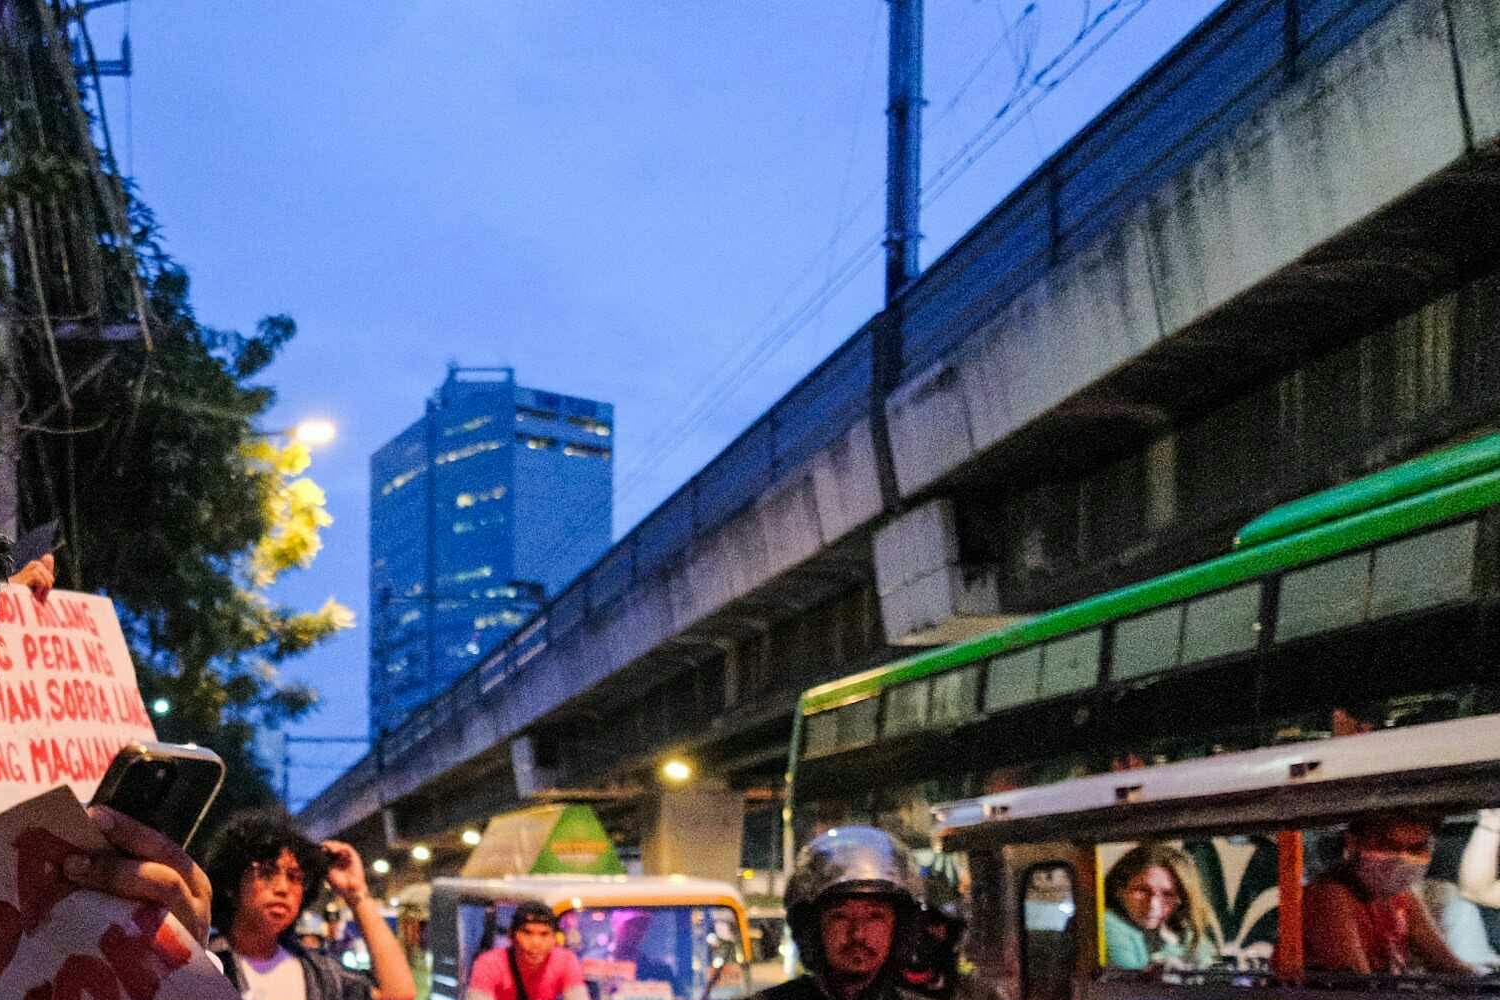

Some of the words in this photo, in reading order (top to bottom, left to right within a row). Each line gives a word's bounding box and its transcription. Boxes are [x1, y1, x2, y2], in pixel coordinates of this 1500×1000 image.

[22, 633, 83, 673] PERA
[81, 638, 113, 677] NG
[46, 678, 115, 726] SOBRA
